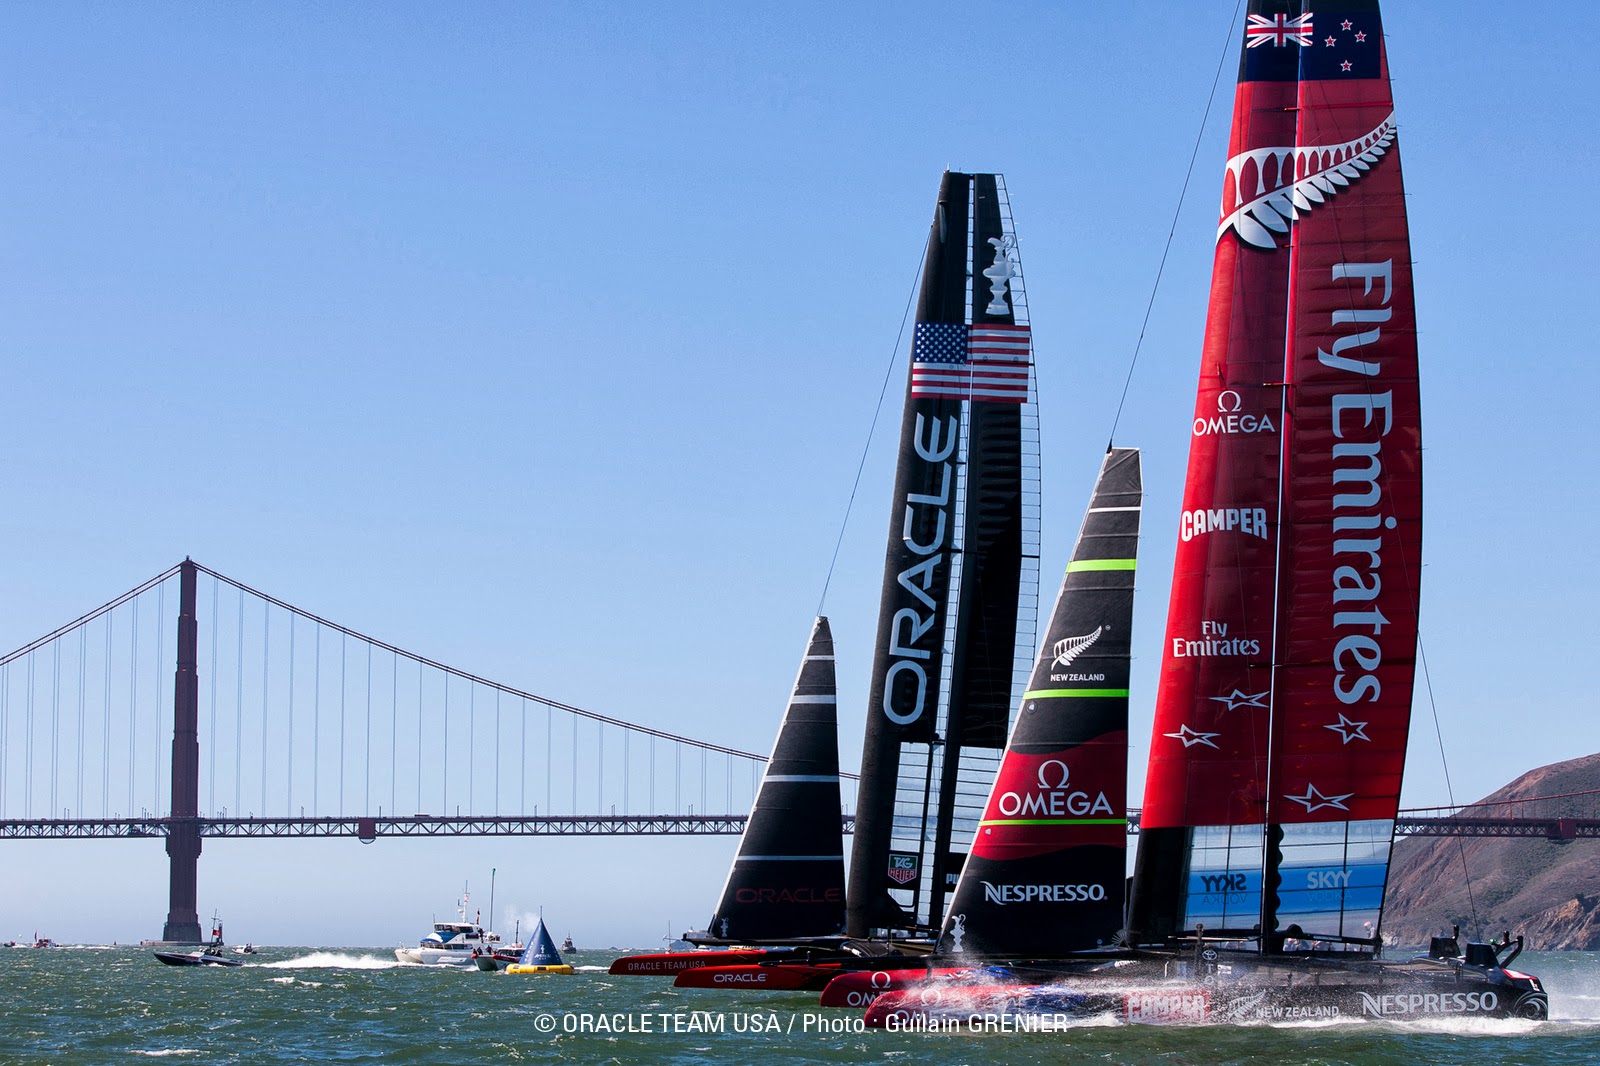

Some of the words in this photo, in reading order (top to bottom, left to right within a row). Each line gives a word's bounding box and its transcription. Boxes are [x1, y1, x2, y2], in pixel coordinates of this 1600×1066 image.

[1317, 257, 1393, 377] Fly
[1193, 414, 1275, 436] OMEGA
[1181, 507, 1268, 542] CAMPER
[1331, 388, 1397, 706] Emirates
[883, 411, 957, 725] ORACLE
[1201, 621, 1227, 637] Fly
[1172, 636, 1260, 657] Emirates
[1050, 674, 1069, 682] NEW
[1068, 673, 1105, 681] ZEALAND
[999, 791, 1114, 816] OMEGA
[893, 857, 913, 869] TAG
[889, 869, 915, 882] HEUER
[1307, 870, 1352, 889] SKYY
[735, 887, 841, 904] ORACLE
[979, 881, 1105, 906] NESPRESSO
[1307, 890, 1353, 902] VODKA
[628, 961, 661, 971] ORACLE
[663, 961, 687, 970] TEAM
[688, 960, 706, 969] USA
[713, 973, 767, 983] ORACLE
[1127, 995, 1206, 1021] CAMPER
[1256, 1007, 1285, 1018] NEW
[1285, 1006, 1340, 1018] ZEALAND
[1356, 991, 1498, 1019] NESPRESSO
